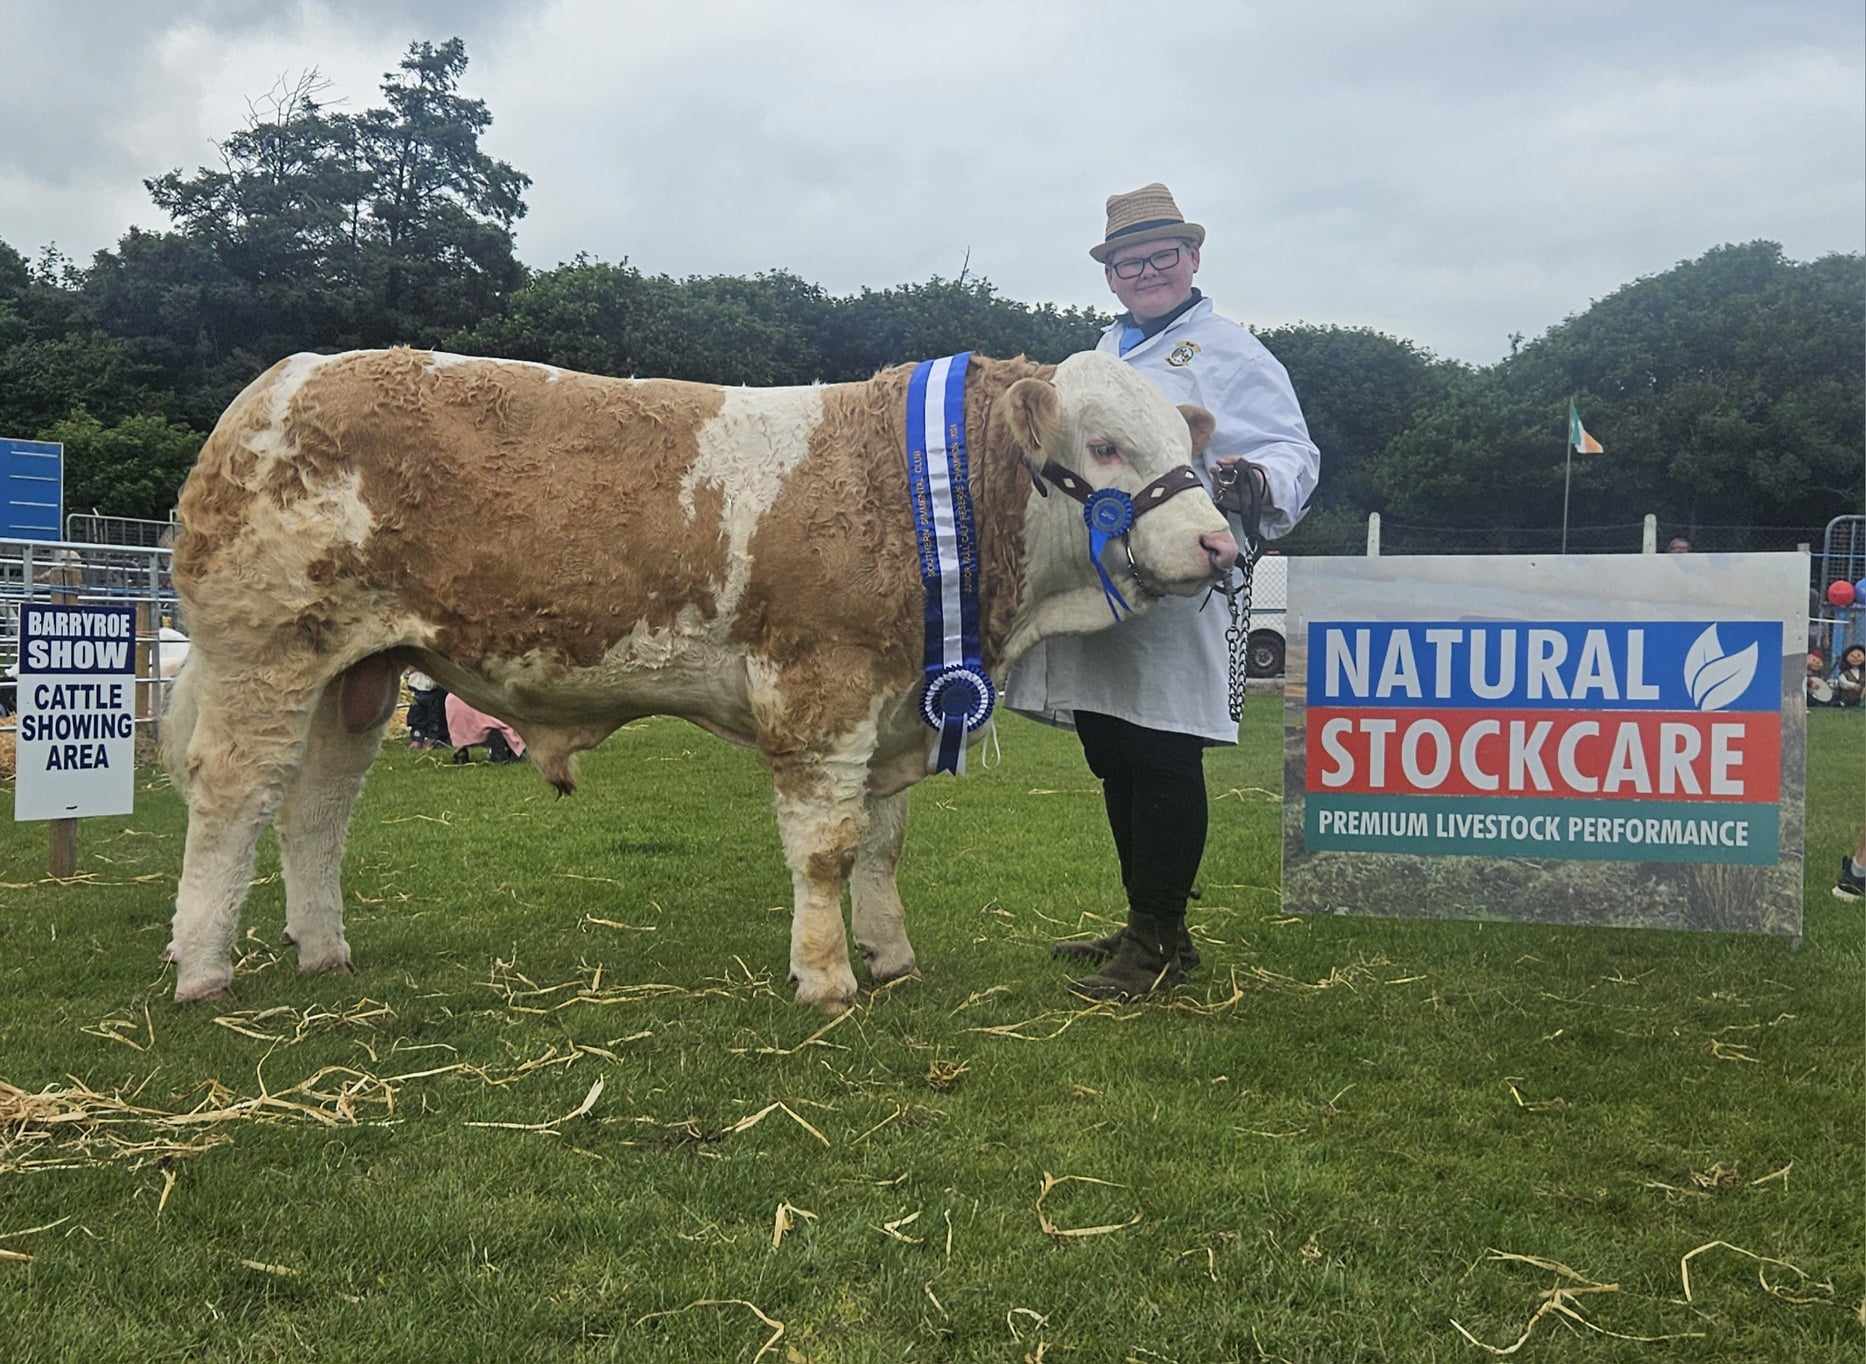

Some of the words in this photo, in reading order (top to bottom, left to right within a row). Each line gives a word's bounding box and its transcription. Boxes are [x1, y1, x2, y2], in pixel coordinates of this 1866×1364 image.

[28, 611, 130, 638] BARRYROE
[28, 639, 129, 669] SHOW
[1325, 628, 1660, 700] NATURAL
[34, 684, 123, 711] CATTLE
[21, 713, 132, 742] SHOWING
[46, 743, 109, 771] AREA
[1320, 717, 1746, 797] STOCKCARE
[1318, 810, 1429, 838] PREMIUM
[1436, 813, 1561, 842] LIVESTOCK
[1567, 816, 1749, 848] PERFORMANCE
